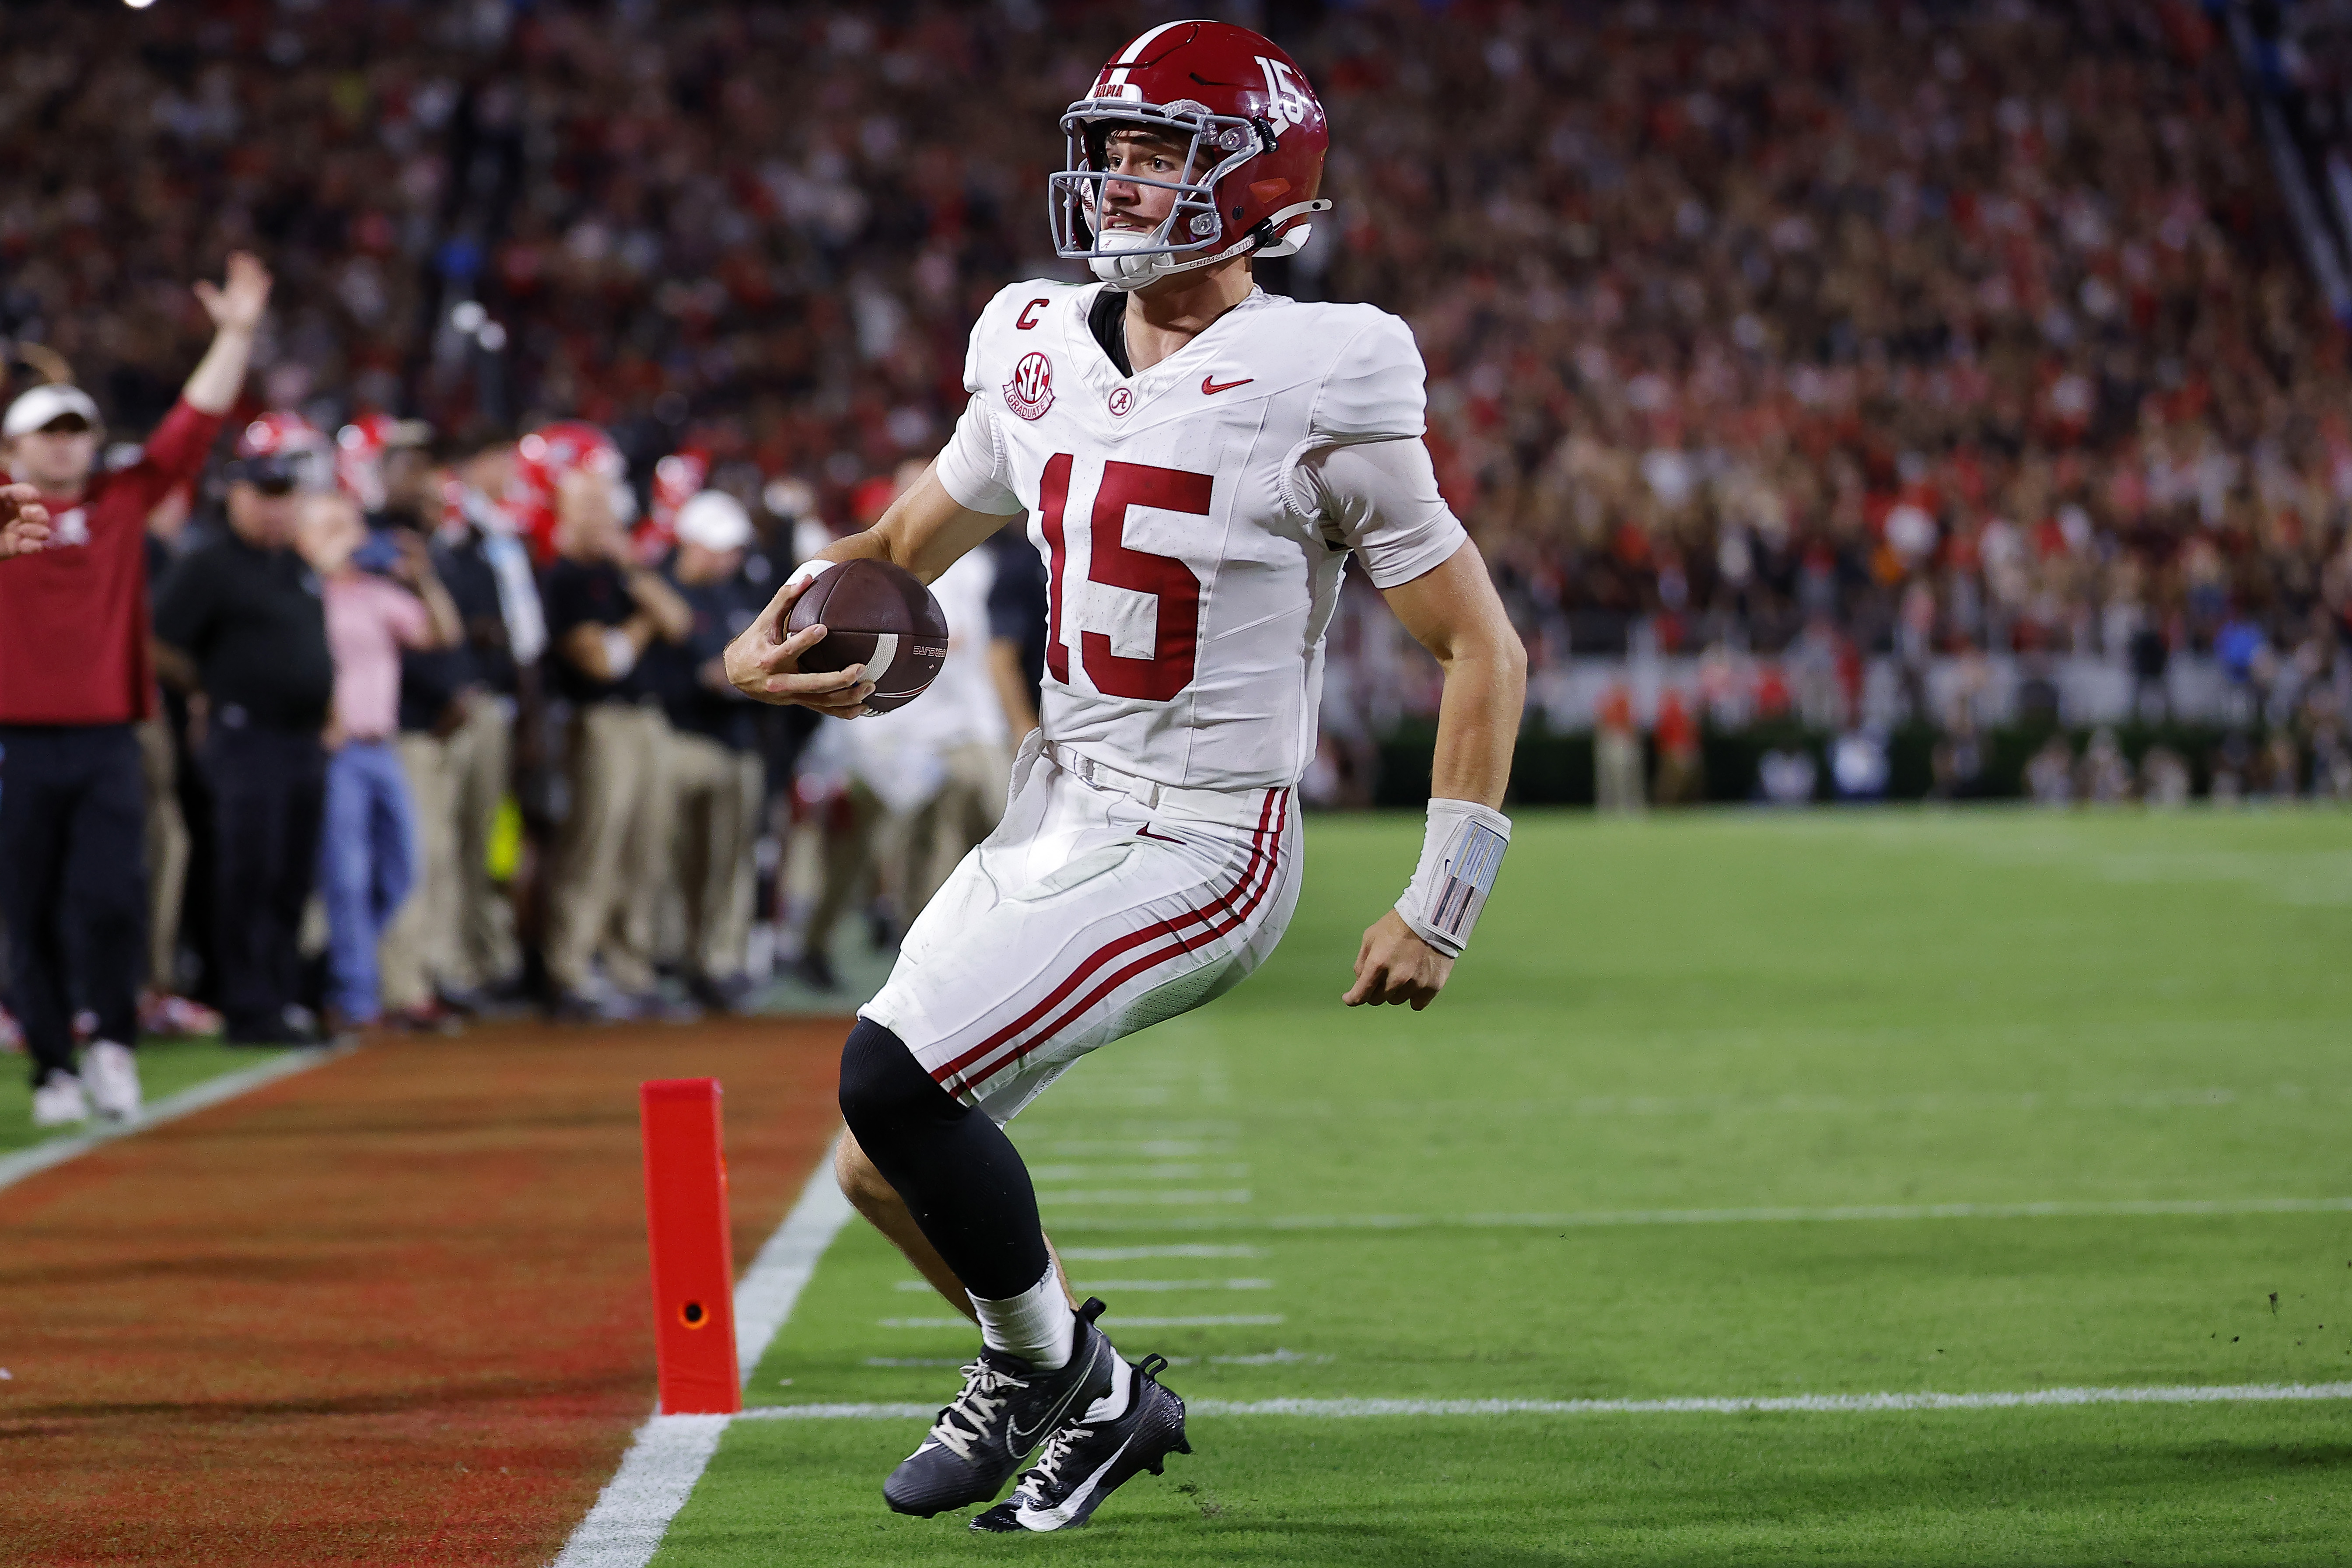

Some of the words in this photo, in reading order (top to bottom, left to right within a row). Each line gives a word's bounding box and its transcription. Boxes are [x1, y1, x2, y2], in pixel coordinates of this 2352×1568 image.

[1254, 56, 1304, 124] 15
[1190, 248, 1233, 268] CRIMSON
[1236, 236, 1255, 252] TIDE
[1016, 298, 1050, 330] C
[1017, 354, 1050, 402] SEC
[1008, 394, 1046, 418] GRADUATE
[1112, 392, 1128, 409] A
[1038, 452, 1214, 702] 15
